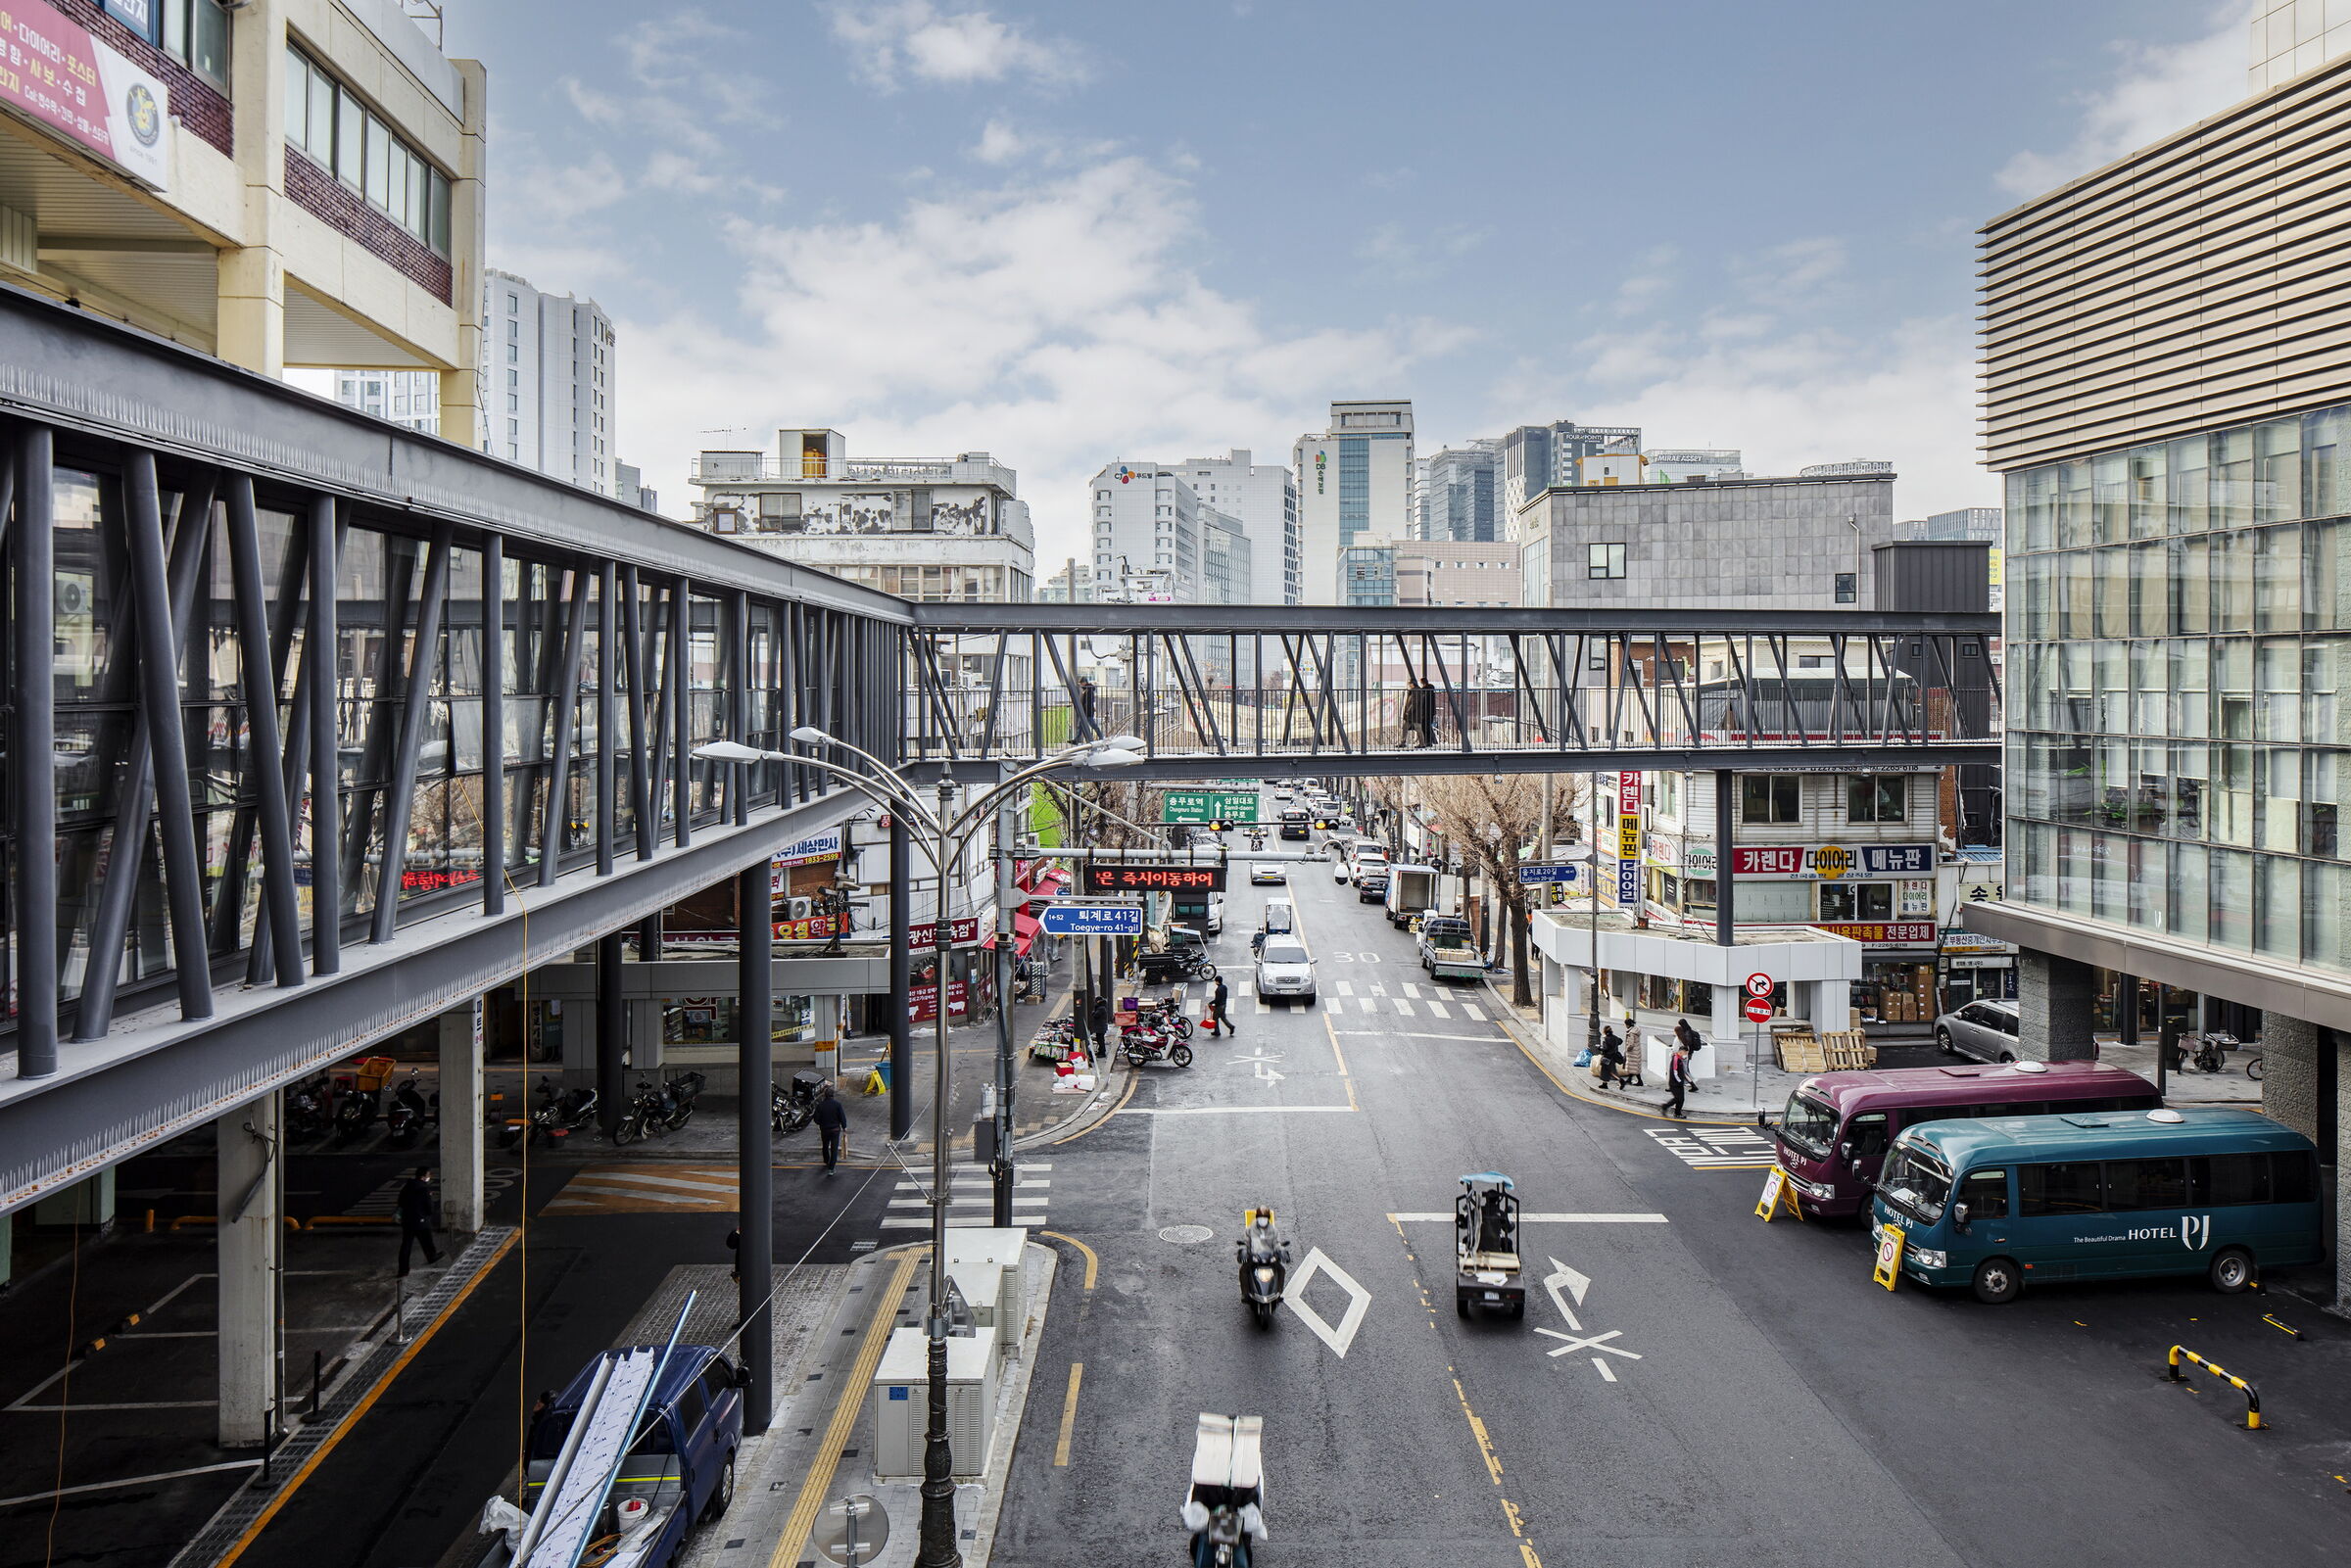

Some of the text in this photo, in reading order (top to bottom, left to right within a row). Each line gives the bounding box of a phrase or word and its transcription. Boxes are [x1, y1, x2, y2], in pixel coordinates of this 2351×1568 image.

[113, 0, 146, 24] 단지
[19, 23, 61, 64] 다이어리
[67, 54, 96, 87] 포스터
[1622, 773, 1638, 814] 카렌다
[1622, 818, 1637, 856] 메뉴판
[805, 854, 839, 864] 1833-2599
[1743, 849, 1921, 872] 카렌다 다이어리 메뉴판
[1096, 871, 1213, 886] 은 즉시이동하여
[1903, 881, 1927, 890] 카렌다
[1903, 892, 1927, 901] 다이어리
[909, 925, 969, 945] 광신육점
[1070, 924, 1138, 933] Toegye-ro 41-gil
[1887, 925, 1929, 940] 전문업체
[1333, 952, 1381, 963] 30
[1783, 1146, 1807, 1166] HOTEL PJ
[1884, 1205, 1913, 1229] HOTEL PJ
[2128, 1227, 2177, 1240] HOTEL
[2181, 1215, 2210, 1251] PJ
